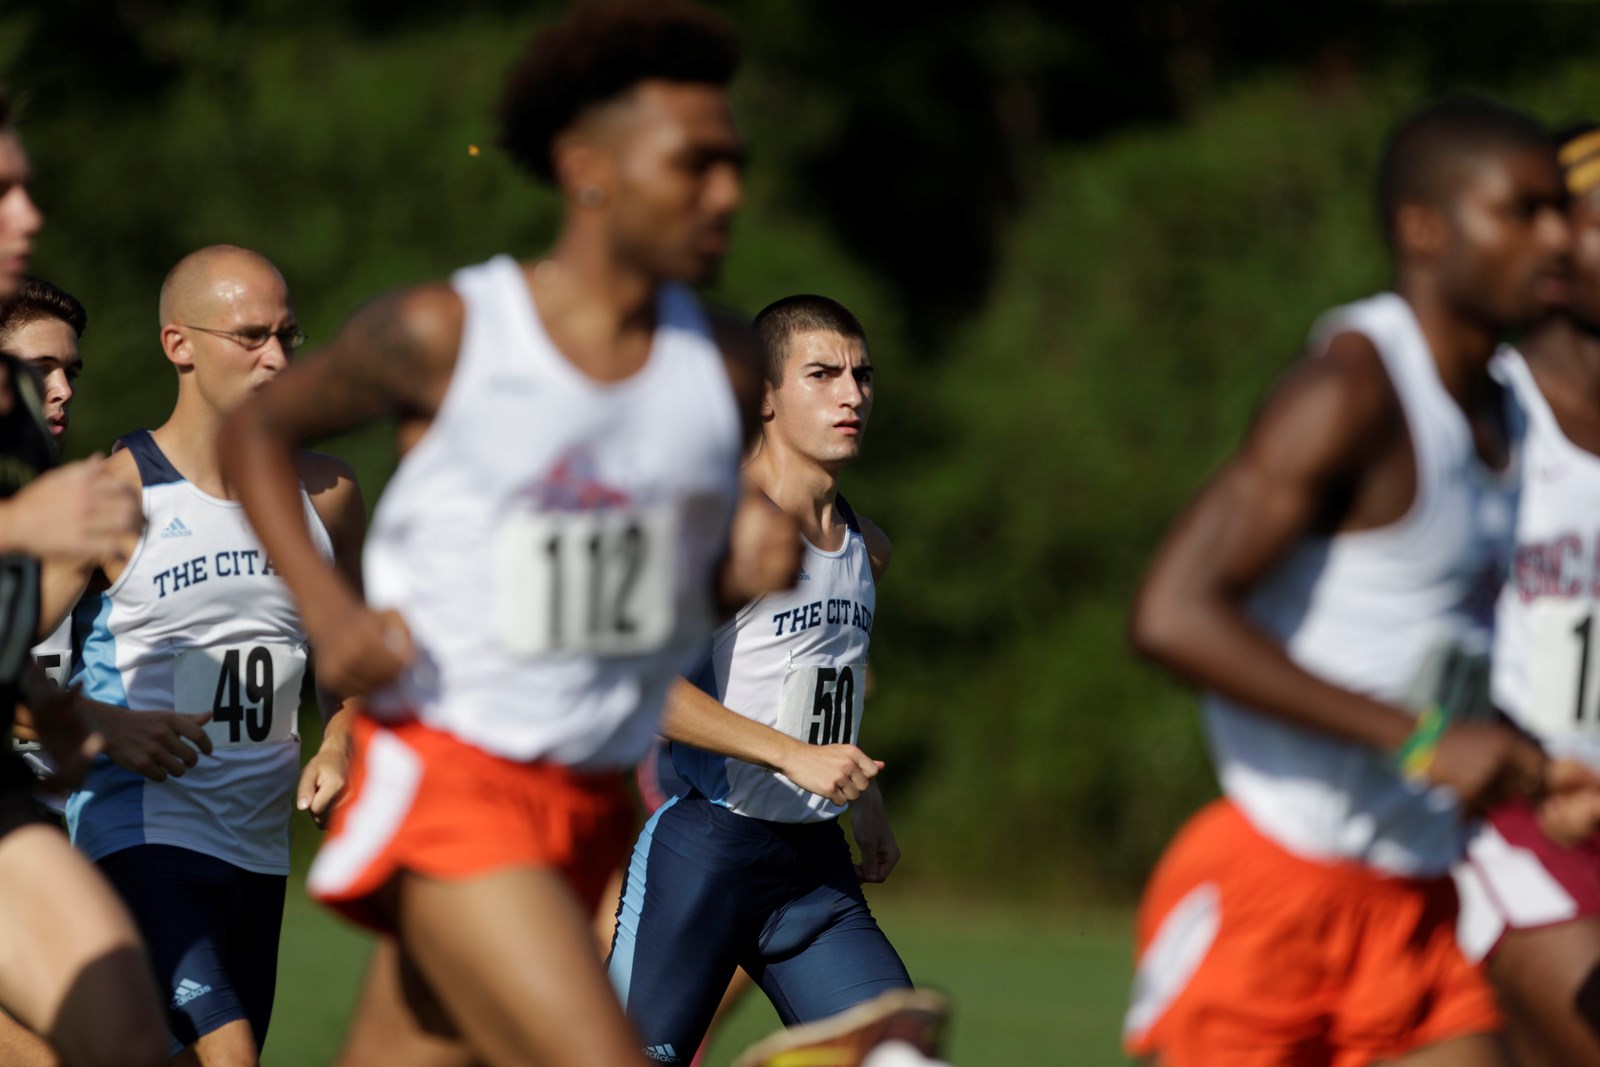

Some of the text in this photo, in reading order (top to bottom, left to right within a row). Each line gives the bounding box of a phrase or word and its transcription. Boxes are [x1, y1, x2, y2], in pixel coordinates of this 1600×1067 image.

[153, 555, 207, 598] THE
[543, 521, 648, 646] 112
[772, 601, 822, 636] THE
[213, 646, 274, 743] 49
[808, 666, 854, 746] 50
[1573, 614, 1600, 723] 1
